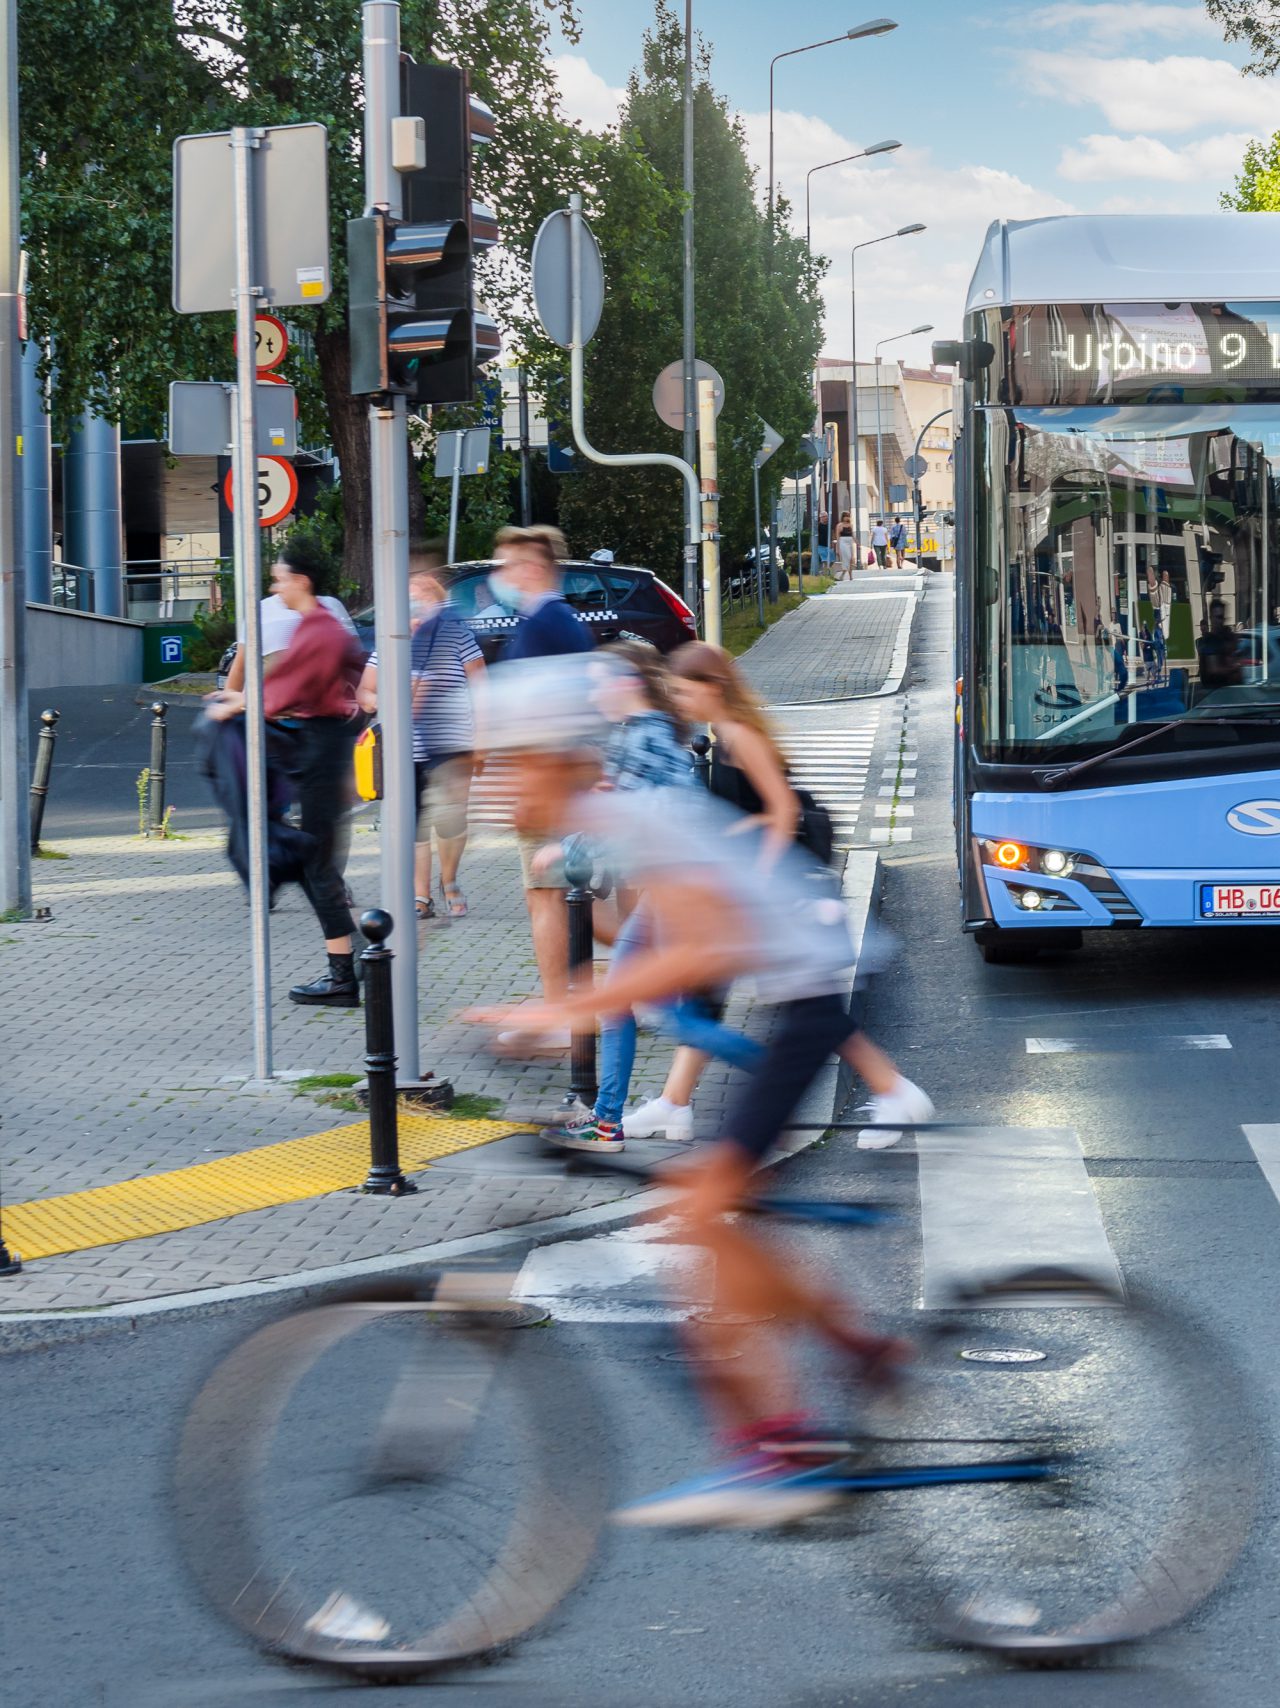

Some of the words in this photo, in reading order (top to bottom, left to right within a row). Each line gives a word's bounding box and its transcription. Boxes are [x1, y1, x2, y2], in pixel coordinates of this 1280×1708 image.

[266, 337, 274, 353] t
[1067, 332, 1196, 372] Urbino
[1220, 333, 1247, 371] 9
[165, 643, 178, 661] P
[1033, 714, 1092, 723] SOLA
[1218, 888, 1245, 909] HB
